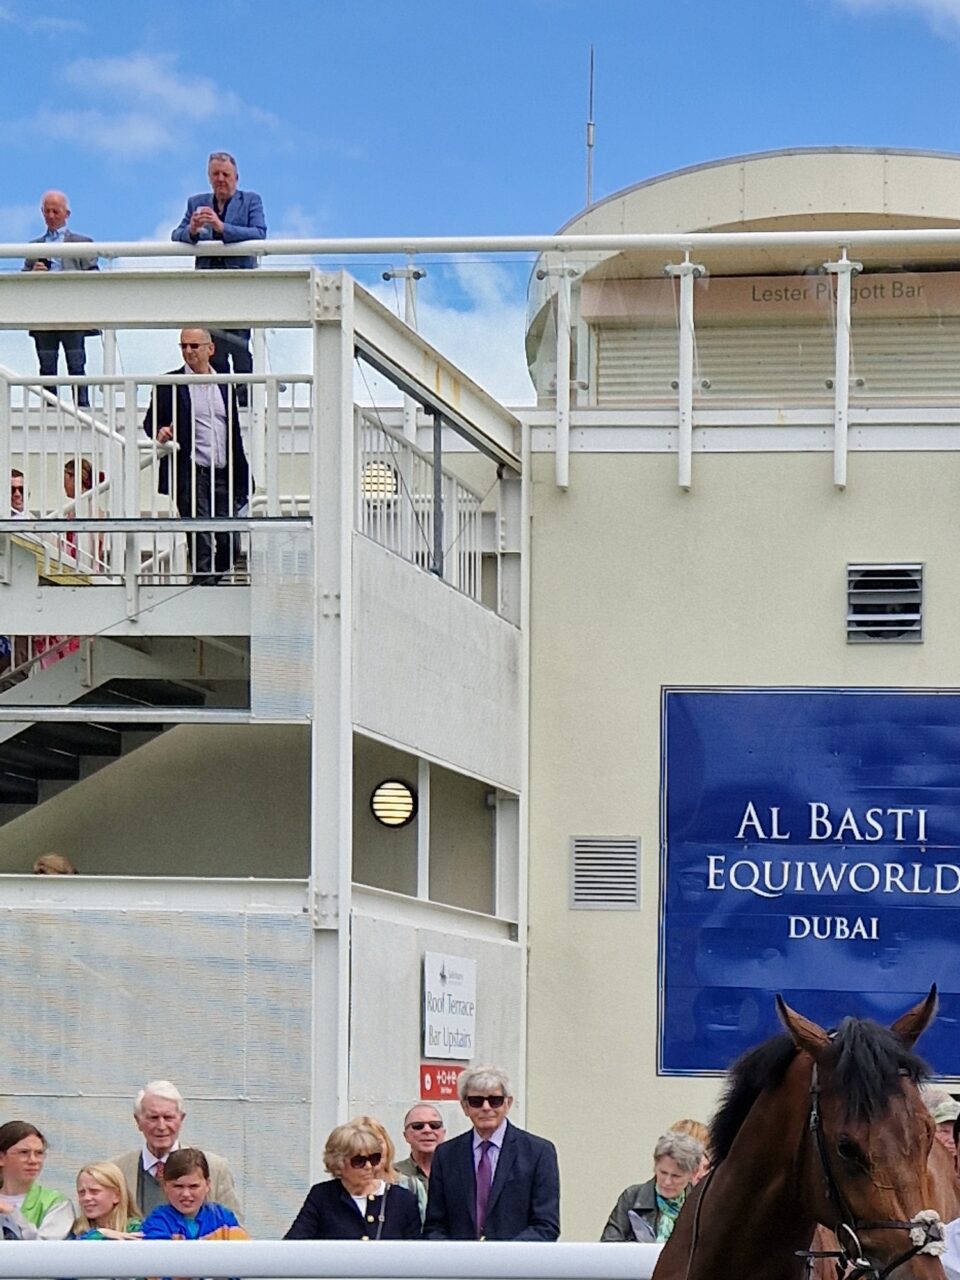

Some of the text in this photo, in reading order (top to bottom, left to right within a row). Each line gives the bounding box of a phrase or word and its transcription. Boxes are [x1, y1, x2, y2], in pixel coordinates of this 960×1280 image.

[752, 284, 808, 302] Lester
[891, 281, 924, 299] Bar
[734, 801, 928, 842] AL BASTI
[788, 915, 880, 940] DUBAI
[427, 991, 474, 1016] Roof Terrace
[429, 1024, 472, 1053] Bar Upstairs
